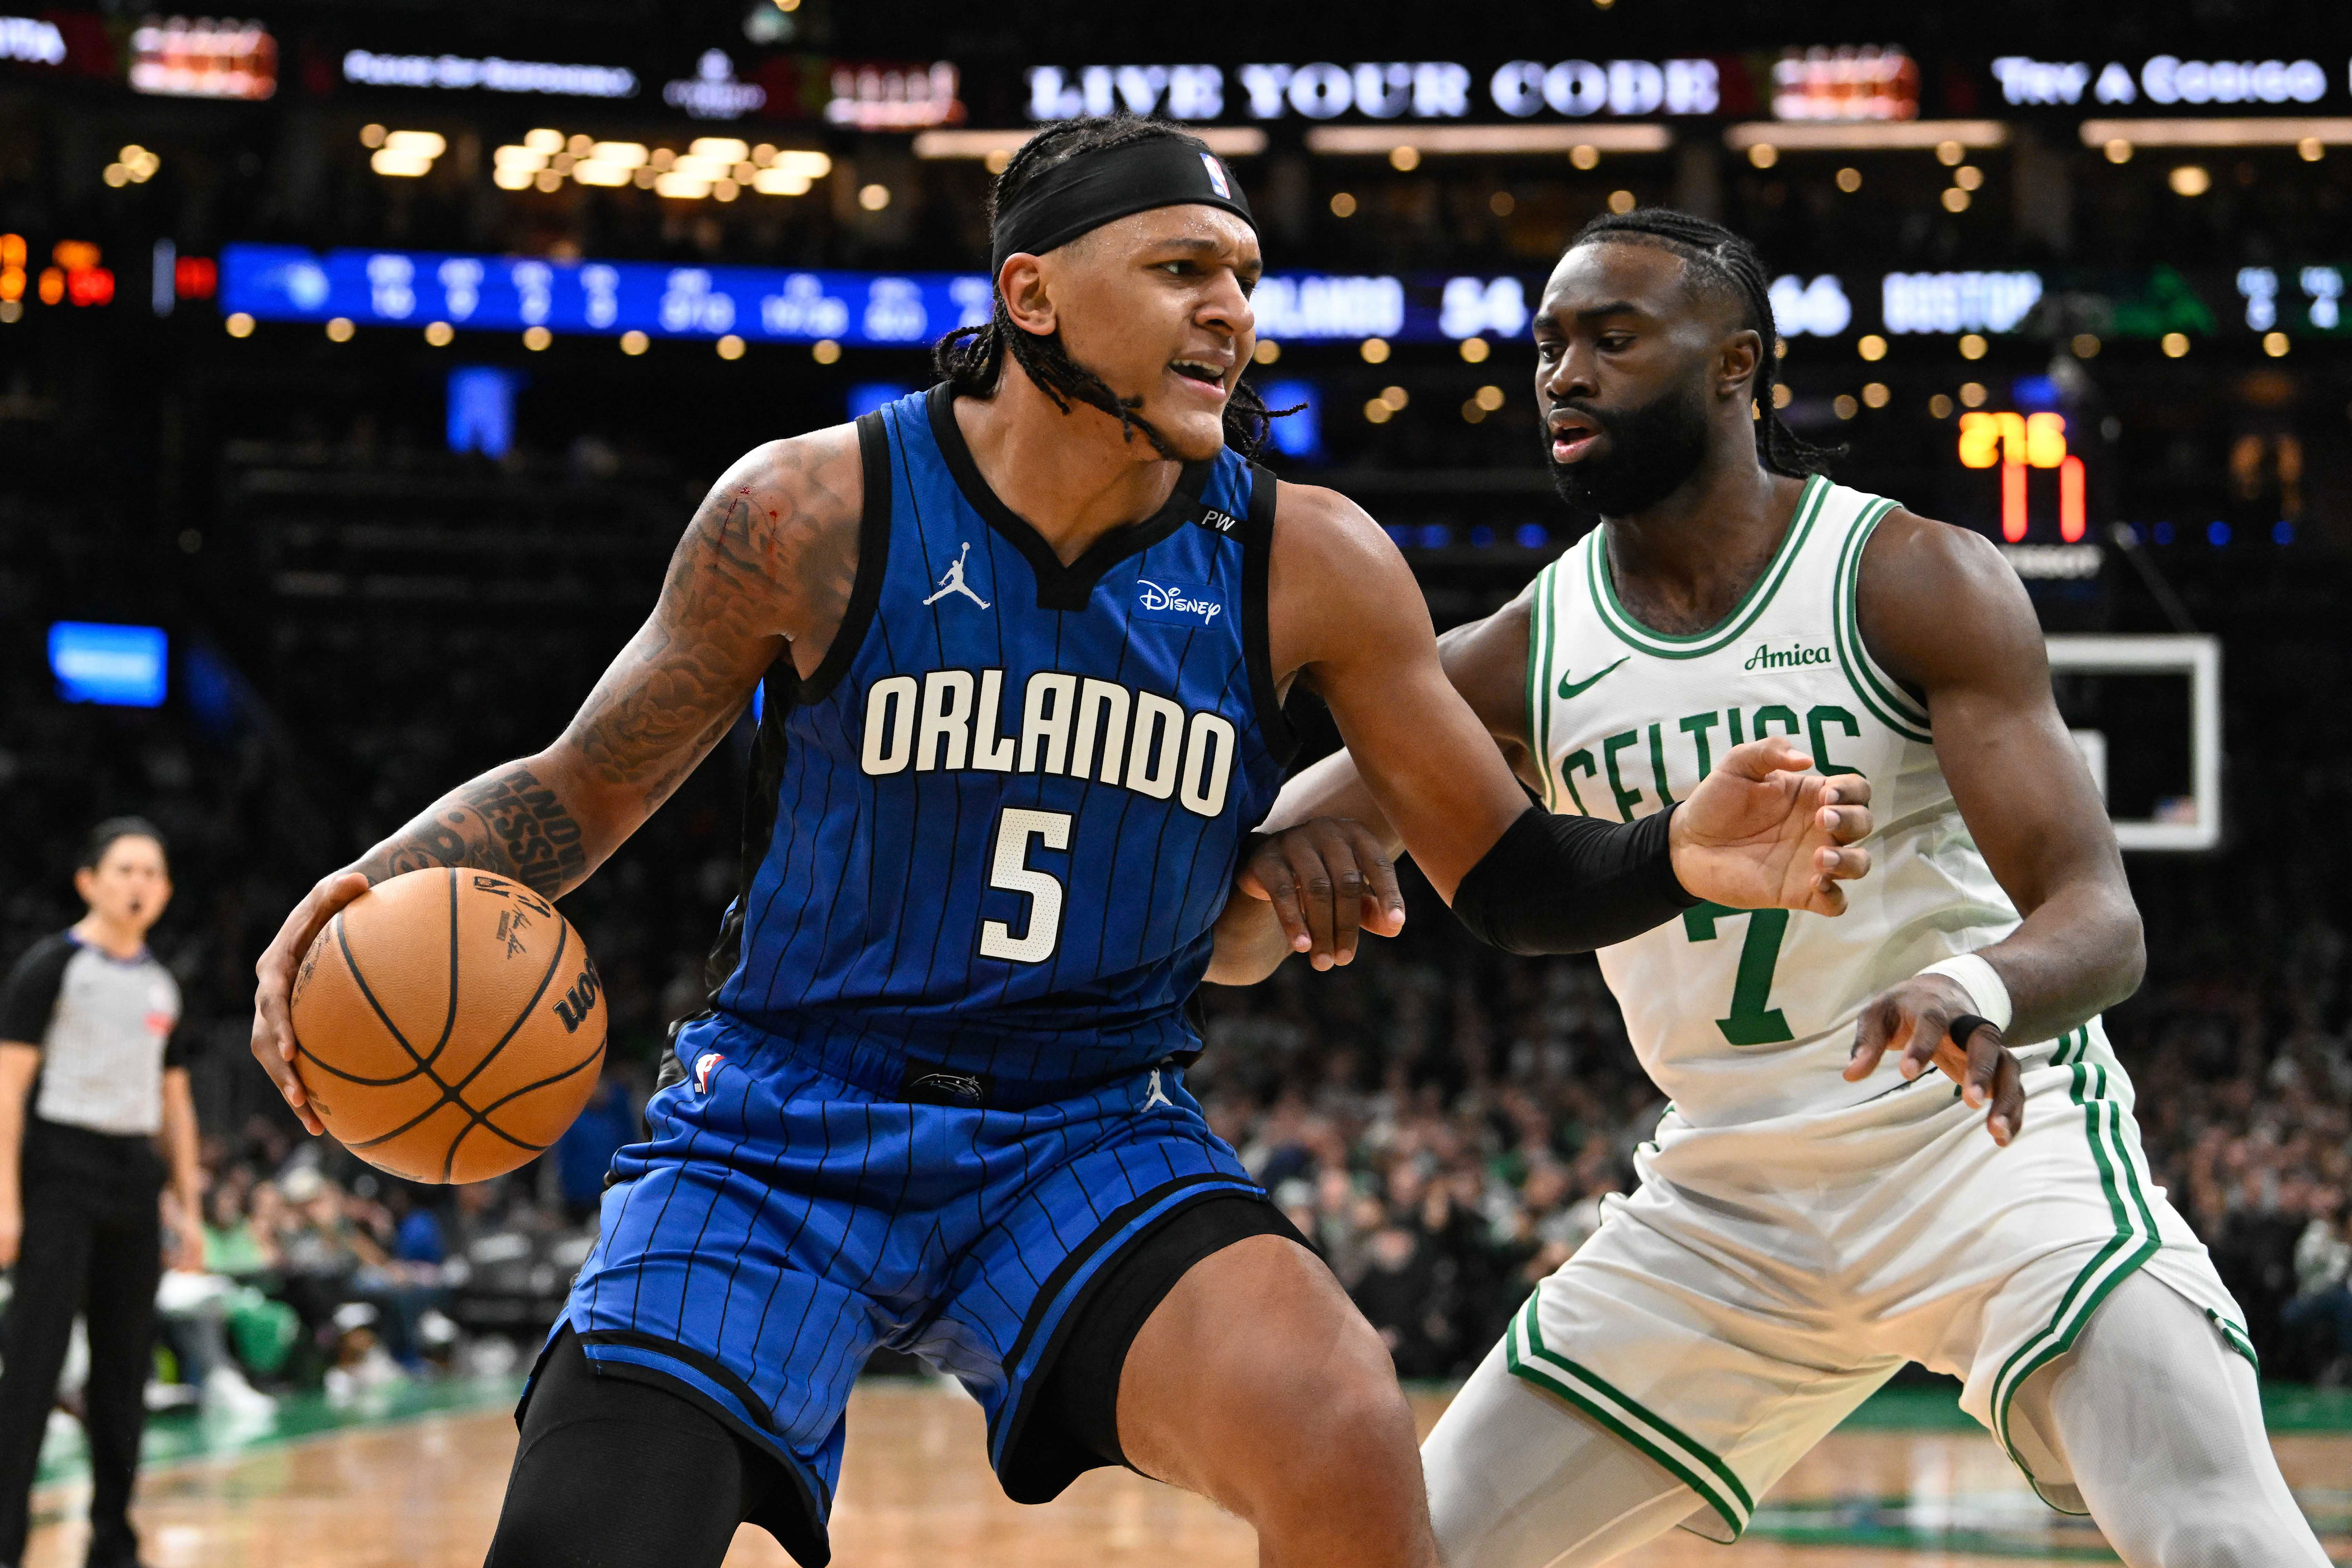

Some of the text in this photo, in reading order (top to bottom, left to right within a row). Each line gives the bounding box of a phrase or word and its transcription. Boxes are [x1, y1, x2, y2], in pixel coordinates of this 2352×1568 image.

[1024, 60, 1720, 119] LIVE YOUR CODE
[1202, 510, 1235, 532] PW
[1745, 644, 1831, 670] Amica
[861, 669, 1235, 818] ORLANDO
[980, 807, 1072, 963] 5
[1683, 900, 1794, 1046] 7
